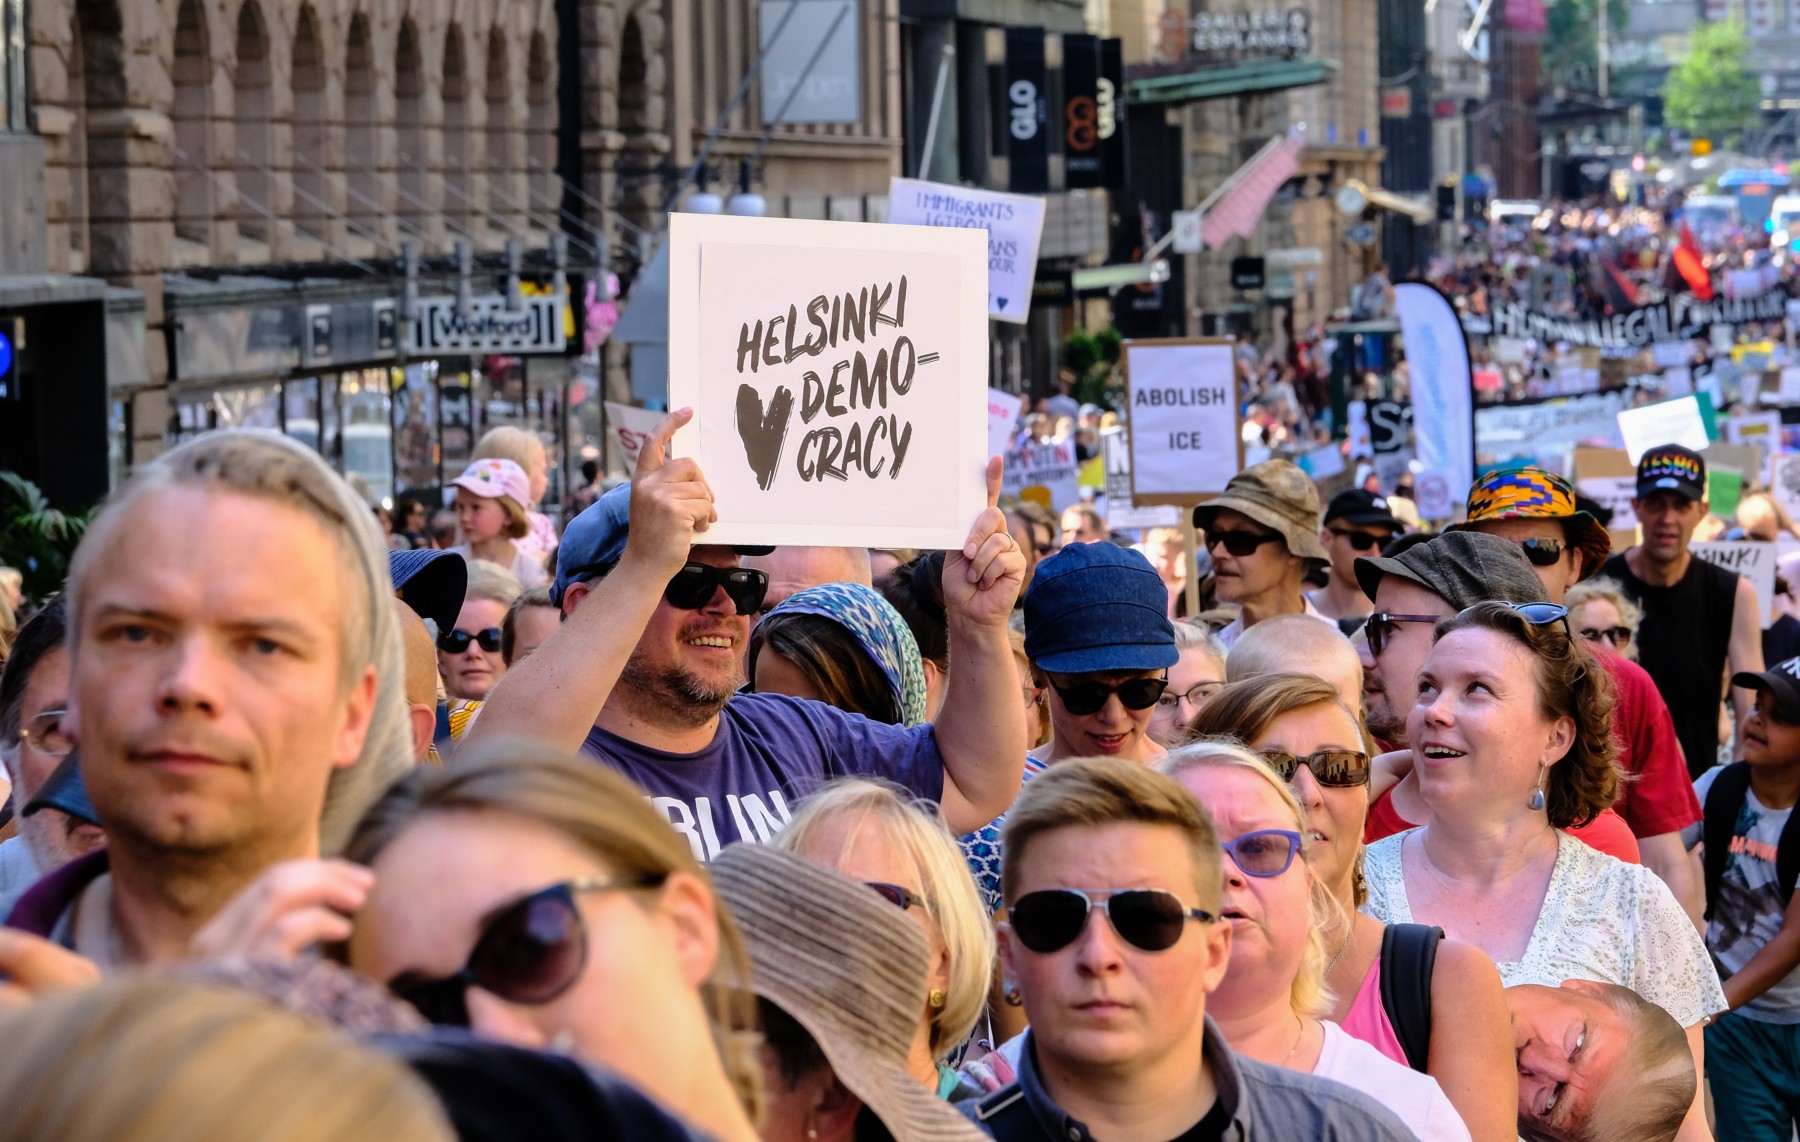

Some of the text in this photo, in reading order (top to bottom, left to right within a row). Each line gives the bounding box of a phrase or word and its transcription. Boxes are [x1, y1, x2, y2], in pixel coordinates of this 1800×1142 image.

[1009, 80, 1038, 140] GLO
[916, 192, 1014, 221] IMMIGRANTS
[988, 240, 1018, 258] ANS
[438, 311, 531, 336] Wolford
[737, 274, 907, 373] HELSINKI
[800, 336, 940, 425] DEMO-
[1135, 387, 1226, 407] ABOLISH
[797, 413, 912, 482] CRACY
[1169, 431, 1202, 451] ICE
[1643, 452, 1700, 481] LESBO
[1692, 547, 1762, 570] SINKI
[640, 790, 793, 862] RLIN
